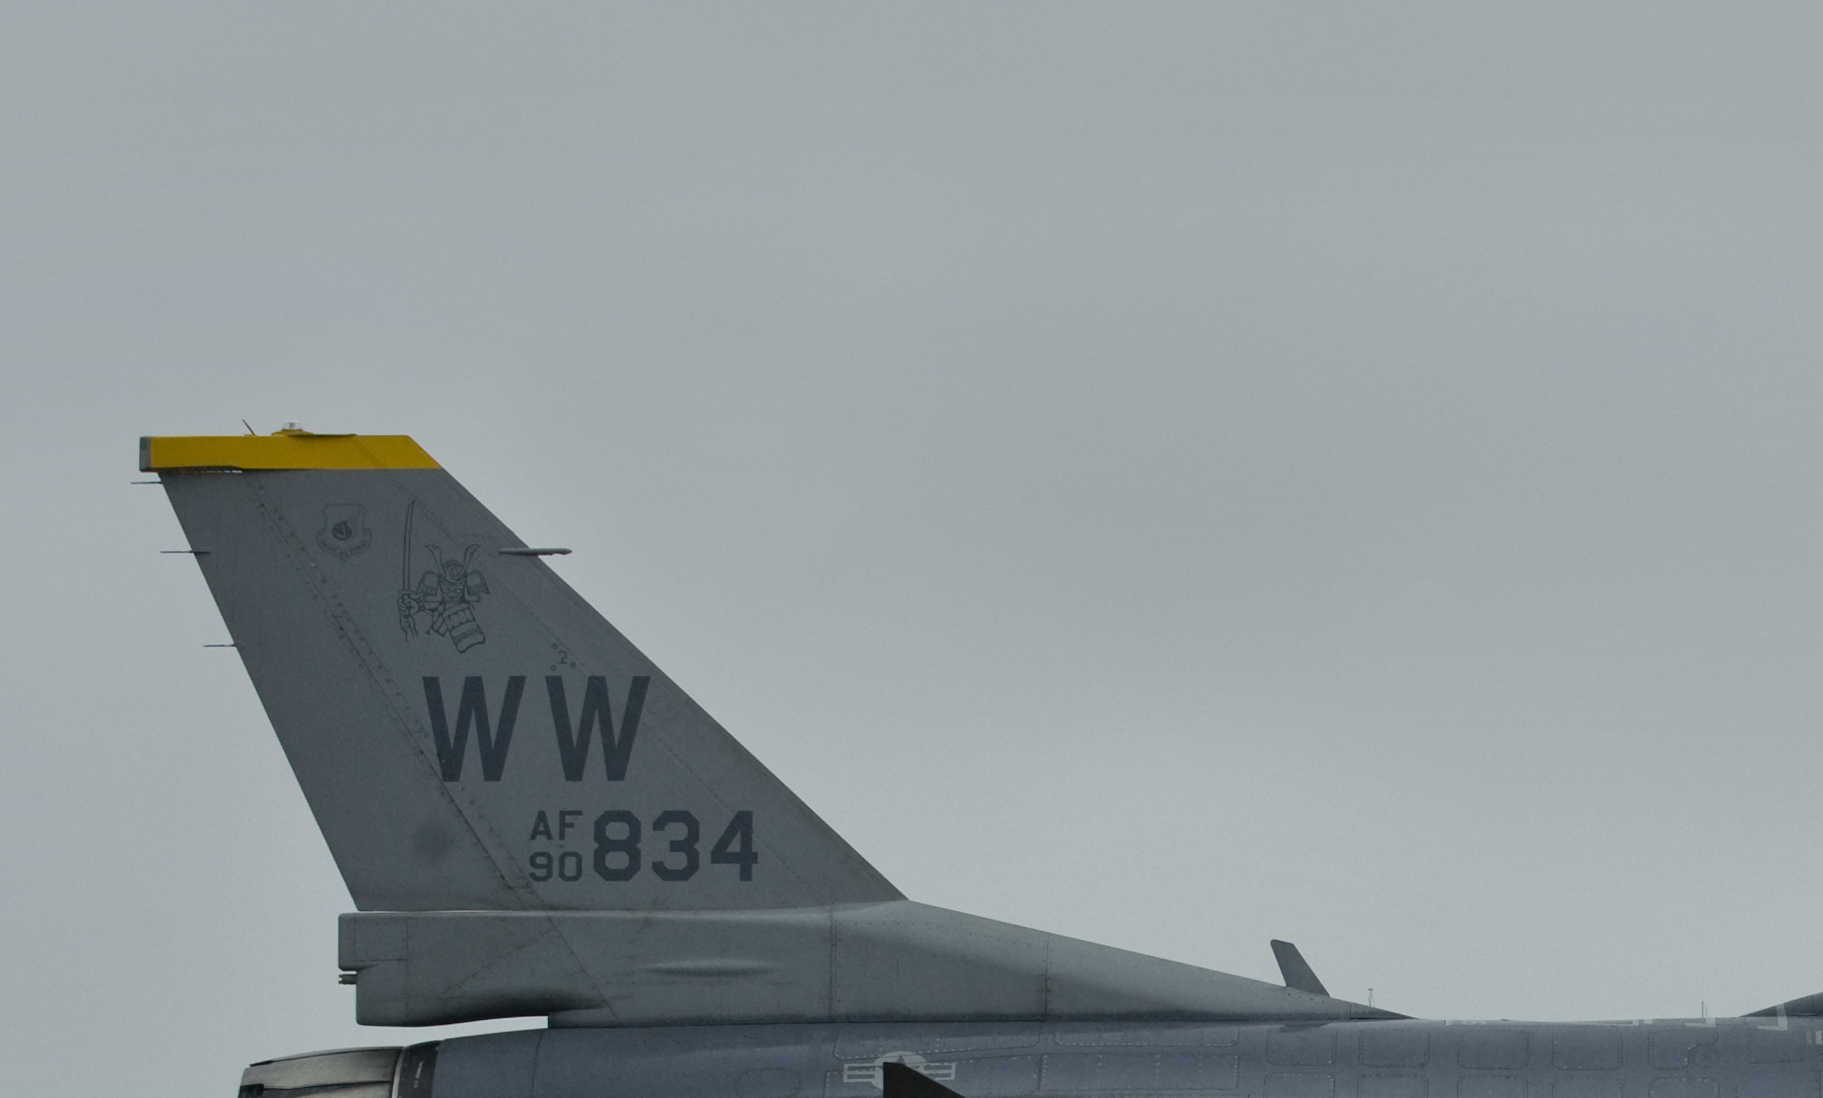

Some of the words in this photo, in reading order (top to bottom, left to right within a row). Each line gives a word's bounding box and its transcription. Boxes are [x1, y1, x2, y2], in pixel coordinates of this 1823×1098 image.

[421, 675, 650, 782] WW
[529, 810, 584, 840] AF
[593, 809, 759, 882] 834
[528, 851, 583, 882] 90
